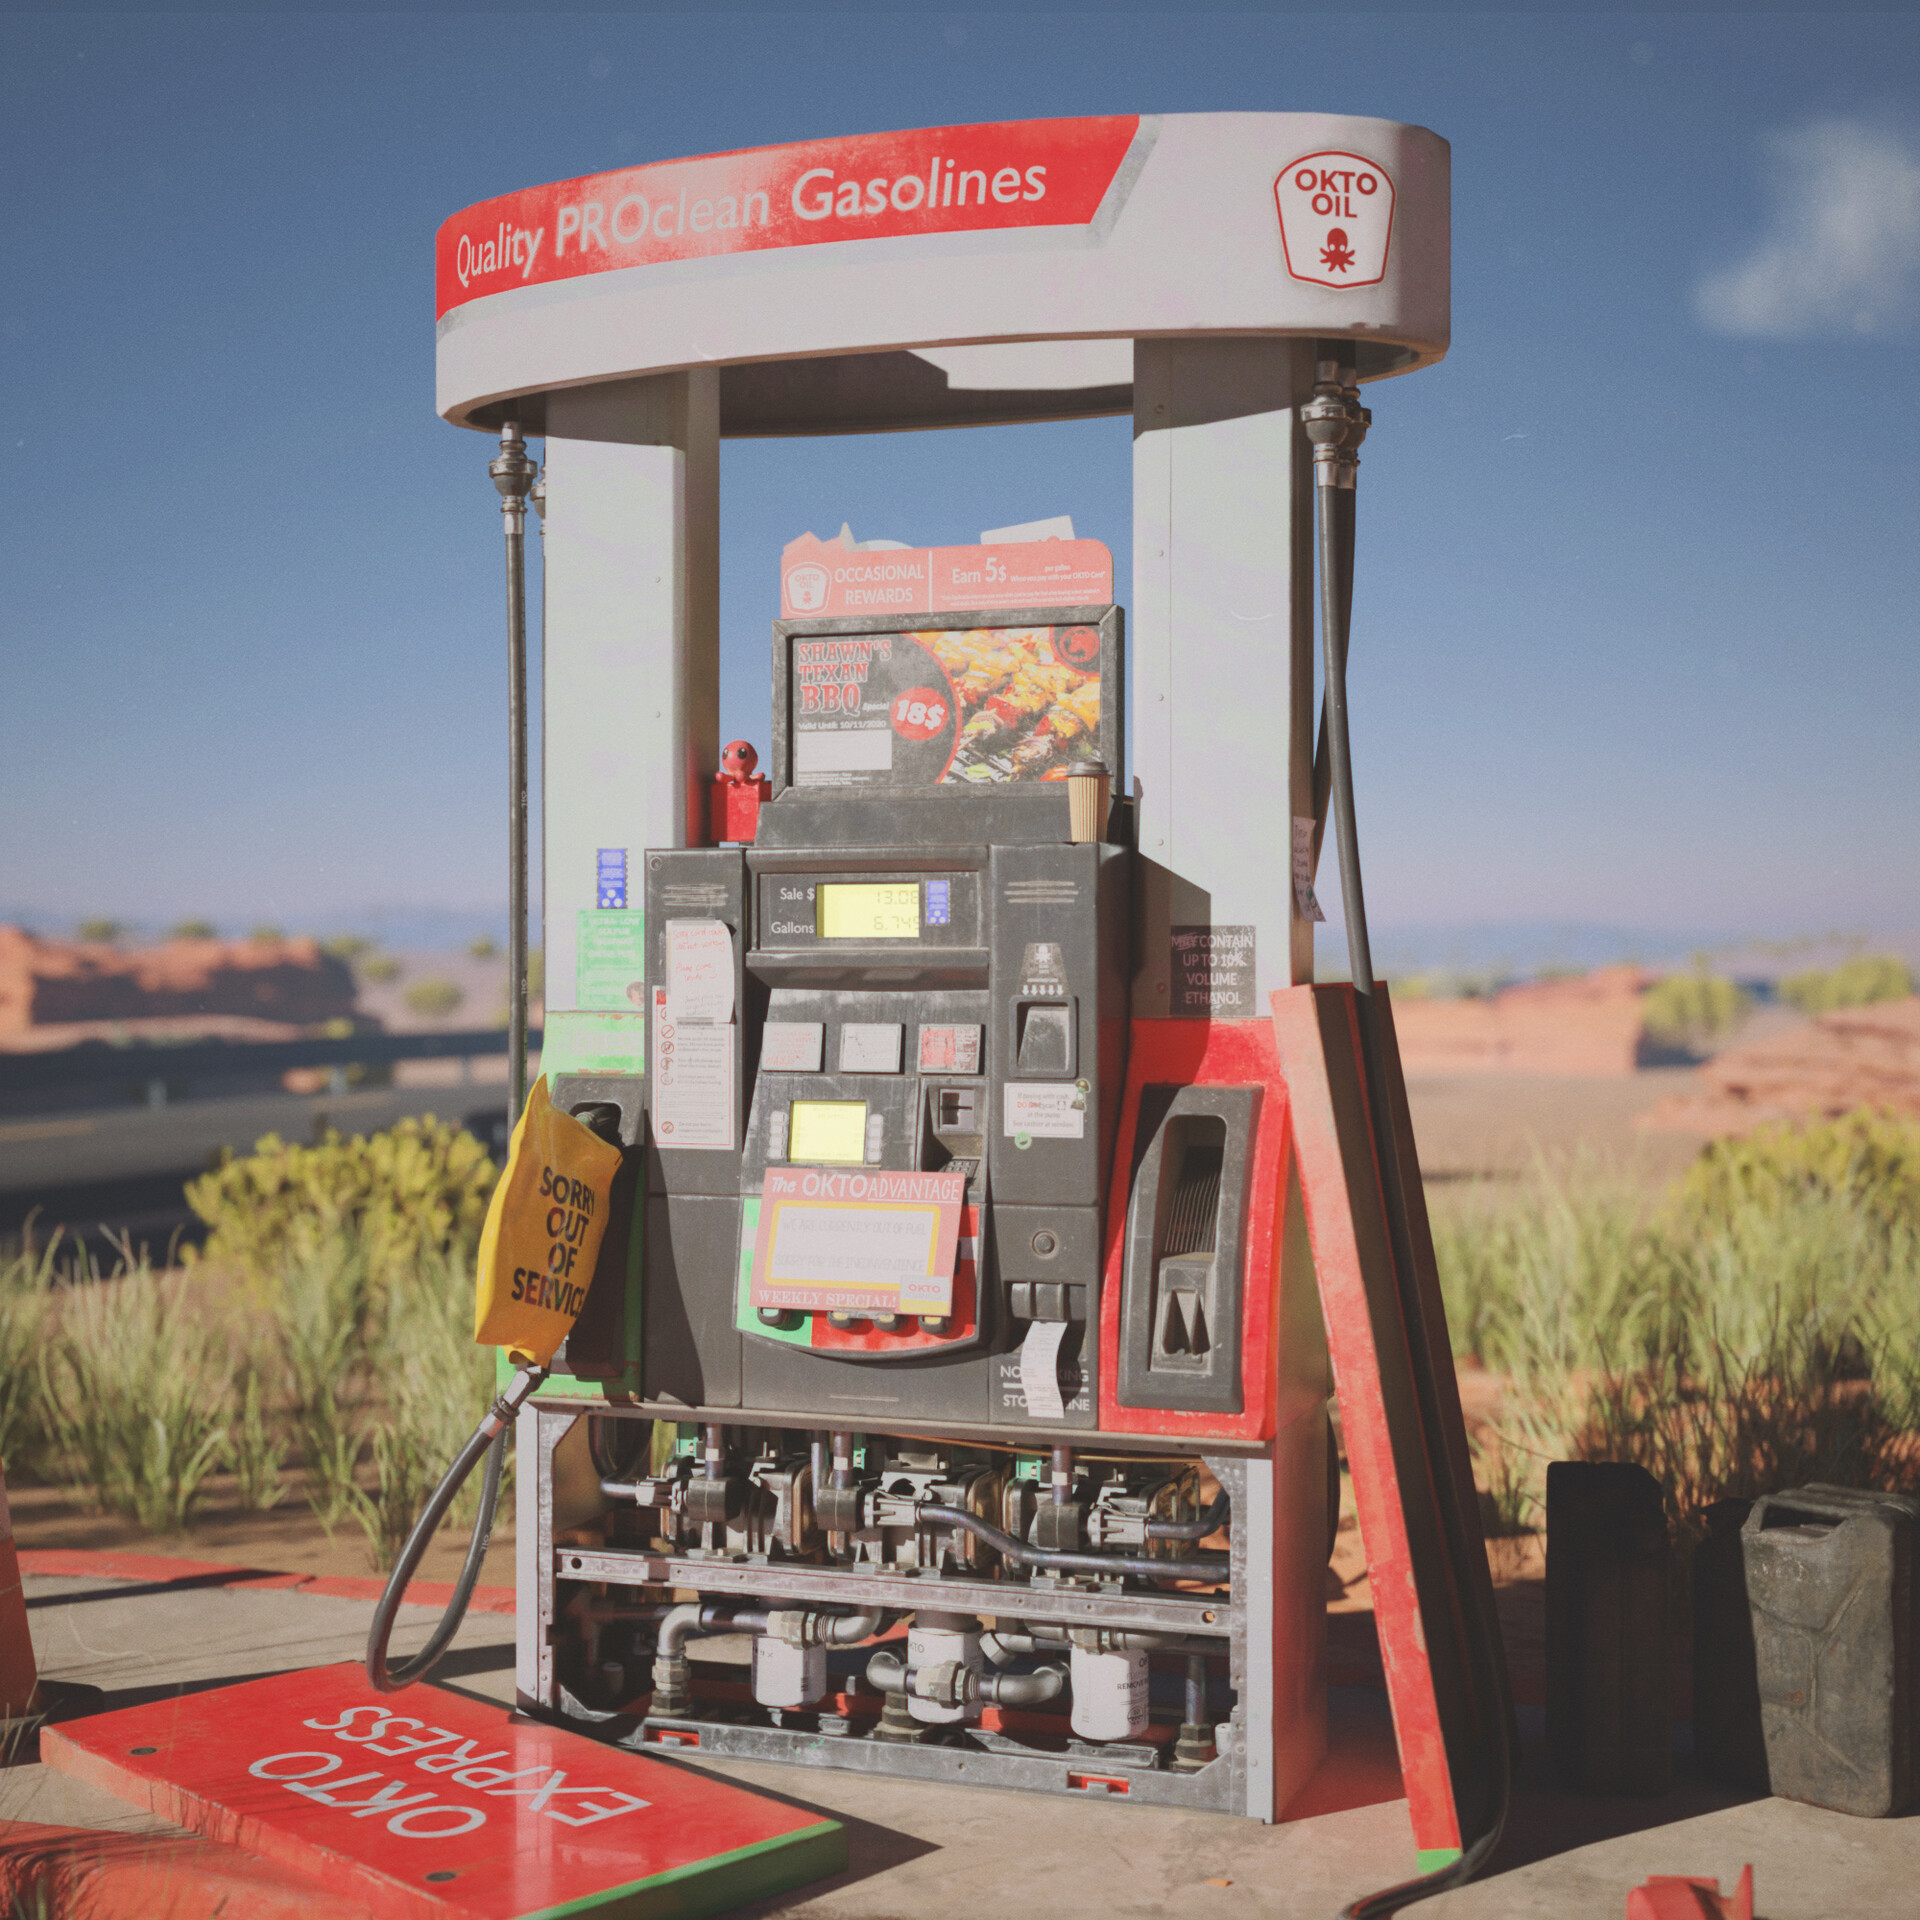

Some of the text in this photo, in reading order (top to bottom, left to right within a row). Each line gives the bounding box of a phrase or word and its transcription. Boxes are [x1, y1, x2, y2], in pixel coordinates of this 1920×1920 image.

[1295, 169, 1378, 195] OKTO
[1311, 193, 1358, 218] OIL
[456, 157, 1047, 288] Quality PROclean Gasolines
[834, 564, 925, 583] OCCASIONAL
[952, 568, 982, 584] Earn
[846, 587, 913, 605] REWARDS
[799, 640, 892, 663] SHAWN'S
[798, 662, 869, 683] TEXAN
[799, 683, 861, 717] BBQ
[896, 699, 946, 731] 18$
[780, 888, 815, 902] Sale $
[771, 921, 815, 934] Gallons
[1200, 934, 1254, 948] CONTAIN
[1183, 954, 1199, 967] UP
[1201, 954, 1217, 967] TO
[1186, 973, 1238, 986] VOLUME
[1185, 991, 1242, 1005] ETHANOL
[539, 1166, 595, 1216] SORRY
[771, 1173, 960, 1201] The OKTO ADVANTAGE
[546, 1207, 589, 1247] OUT
[548, 1242, 578, 1277] OF
[759, 1289, 896, 1309] WEEKLY SPECIAL!
[908, 1283, 941, 1294] OKTO
[303, 1706, 653, 1826] EXPRESS
[248, 1751, 487, 1838] OKTO
